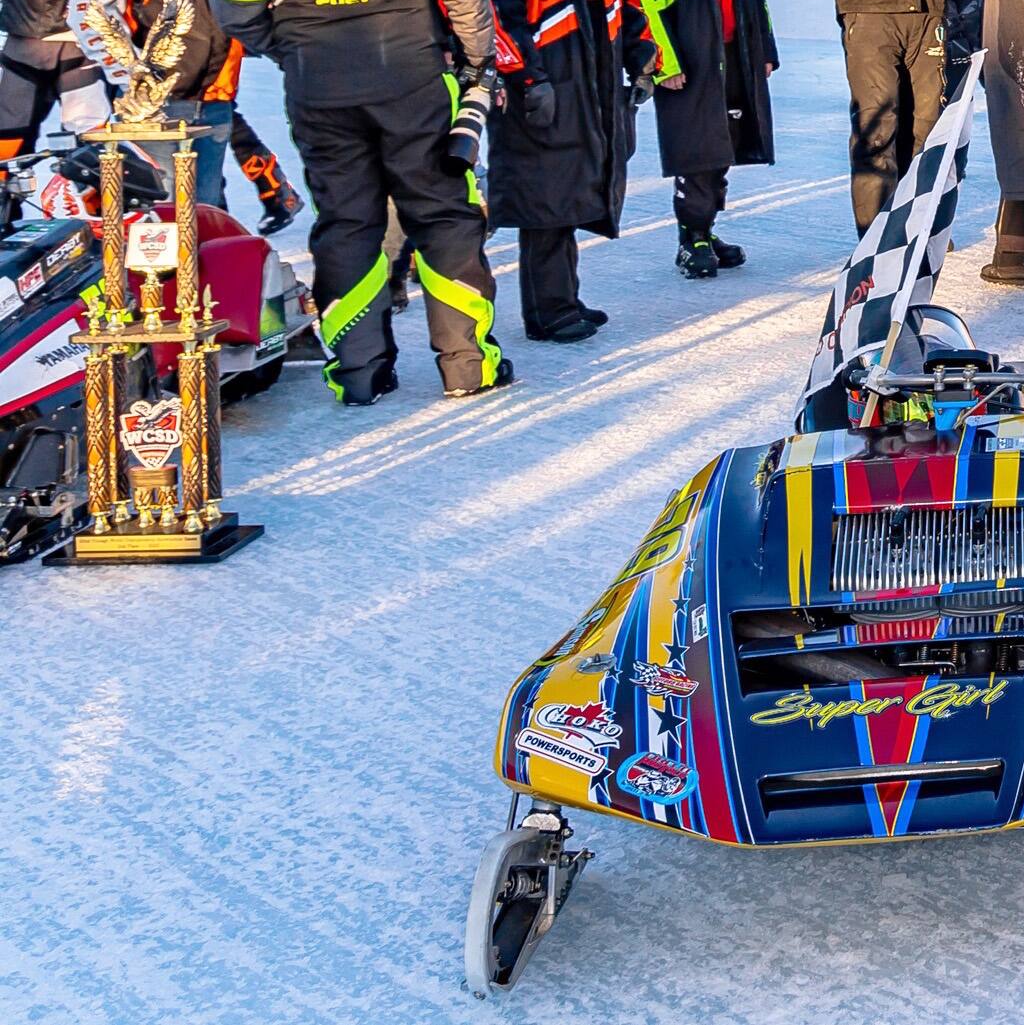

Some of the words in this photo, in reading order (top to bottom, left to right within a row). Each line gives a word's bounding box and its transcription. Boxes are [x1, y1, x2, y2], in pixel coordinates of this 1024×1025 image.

[76, 2, 129, 79] RACNG
[45, 231, 81, 267] DERBY
[138, 241, 168, 252] WCSD
[43, 342, 91, 368] YAMAHA
[126, 430, 180, 446] WCSD
[750, 693, 904, 729] Super
[904, 678, 1009, 719] Girl
[536, 704, 623, 739] CHOKO
[523, 733, 598, 770] POWERSPORTS
